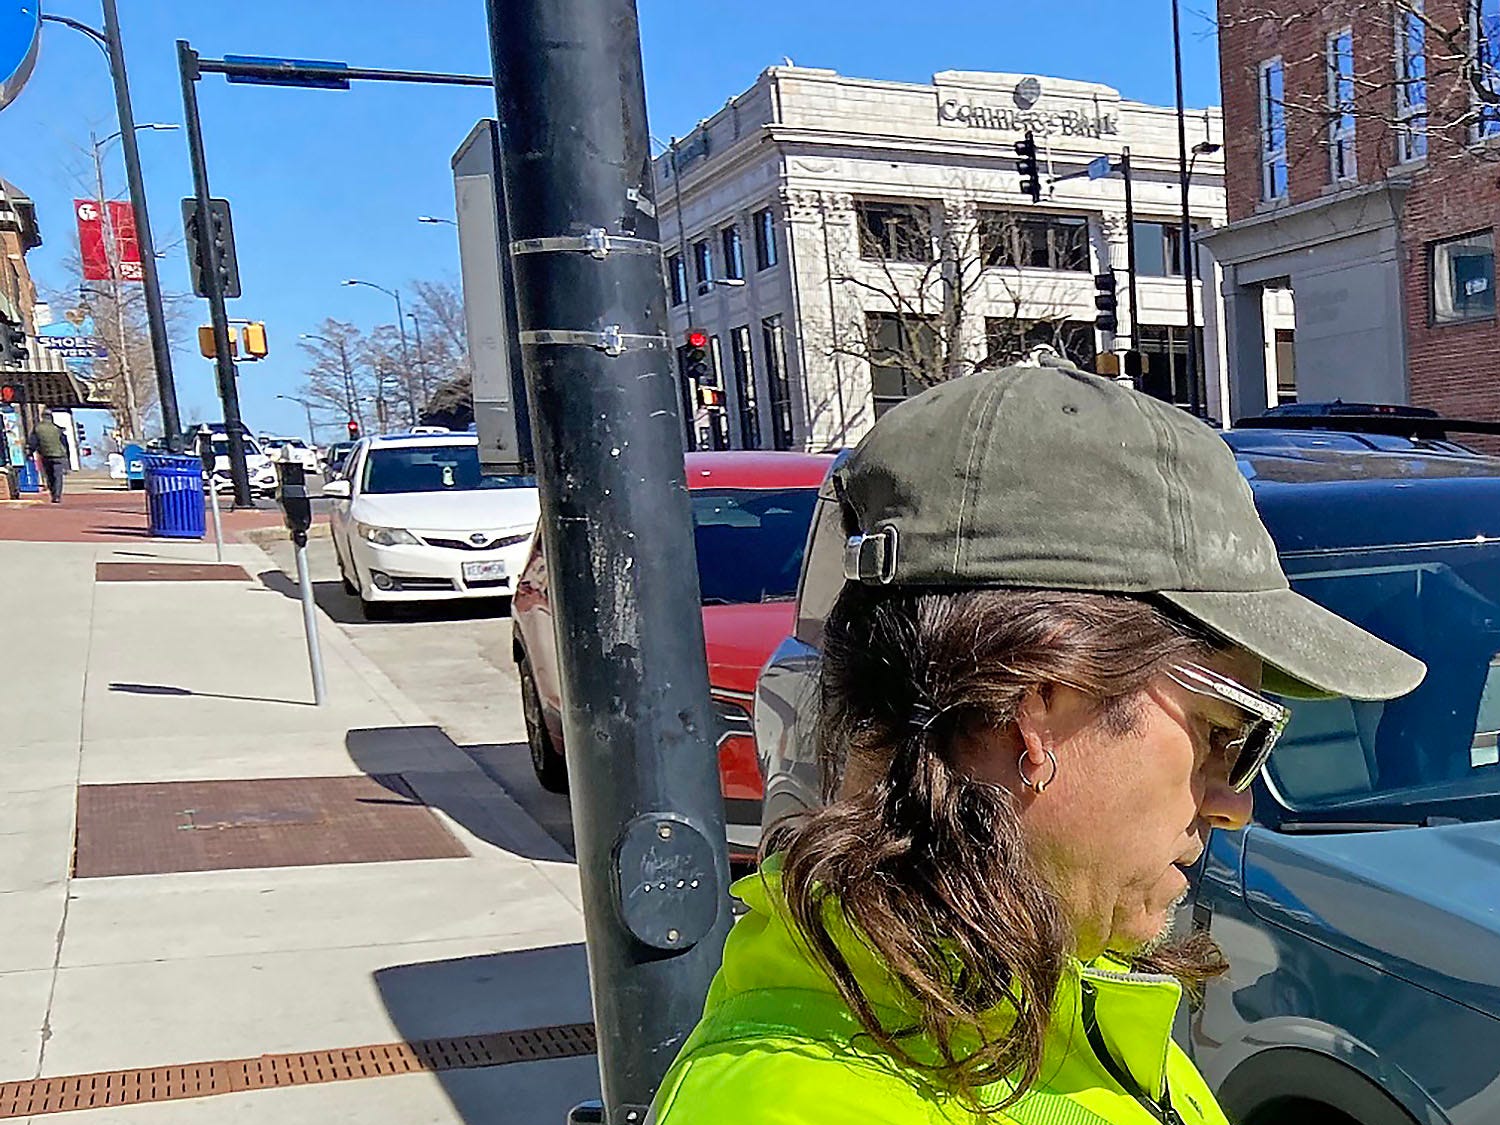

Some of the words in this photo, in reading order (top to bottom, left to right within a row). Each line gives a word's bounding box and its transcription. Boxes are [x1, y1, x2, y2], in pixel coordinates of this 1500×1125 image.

[940, 99, 1060, 135] Commerce
[1061, 110, 1120, 138] Bank
[38, 336, 97, 348] SHOES
